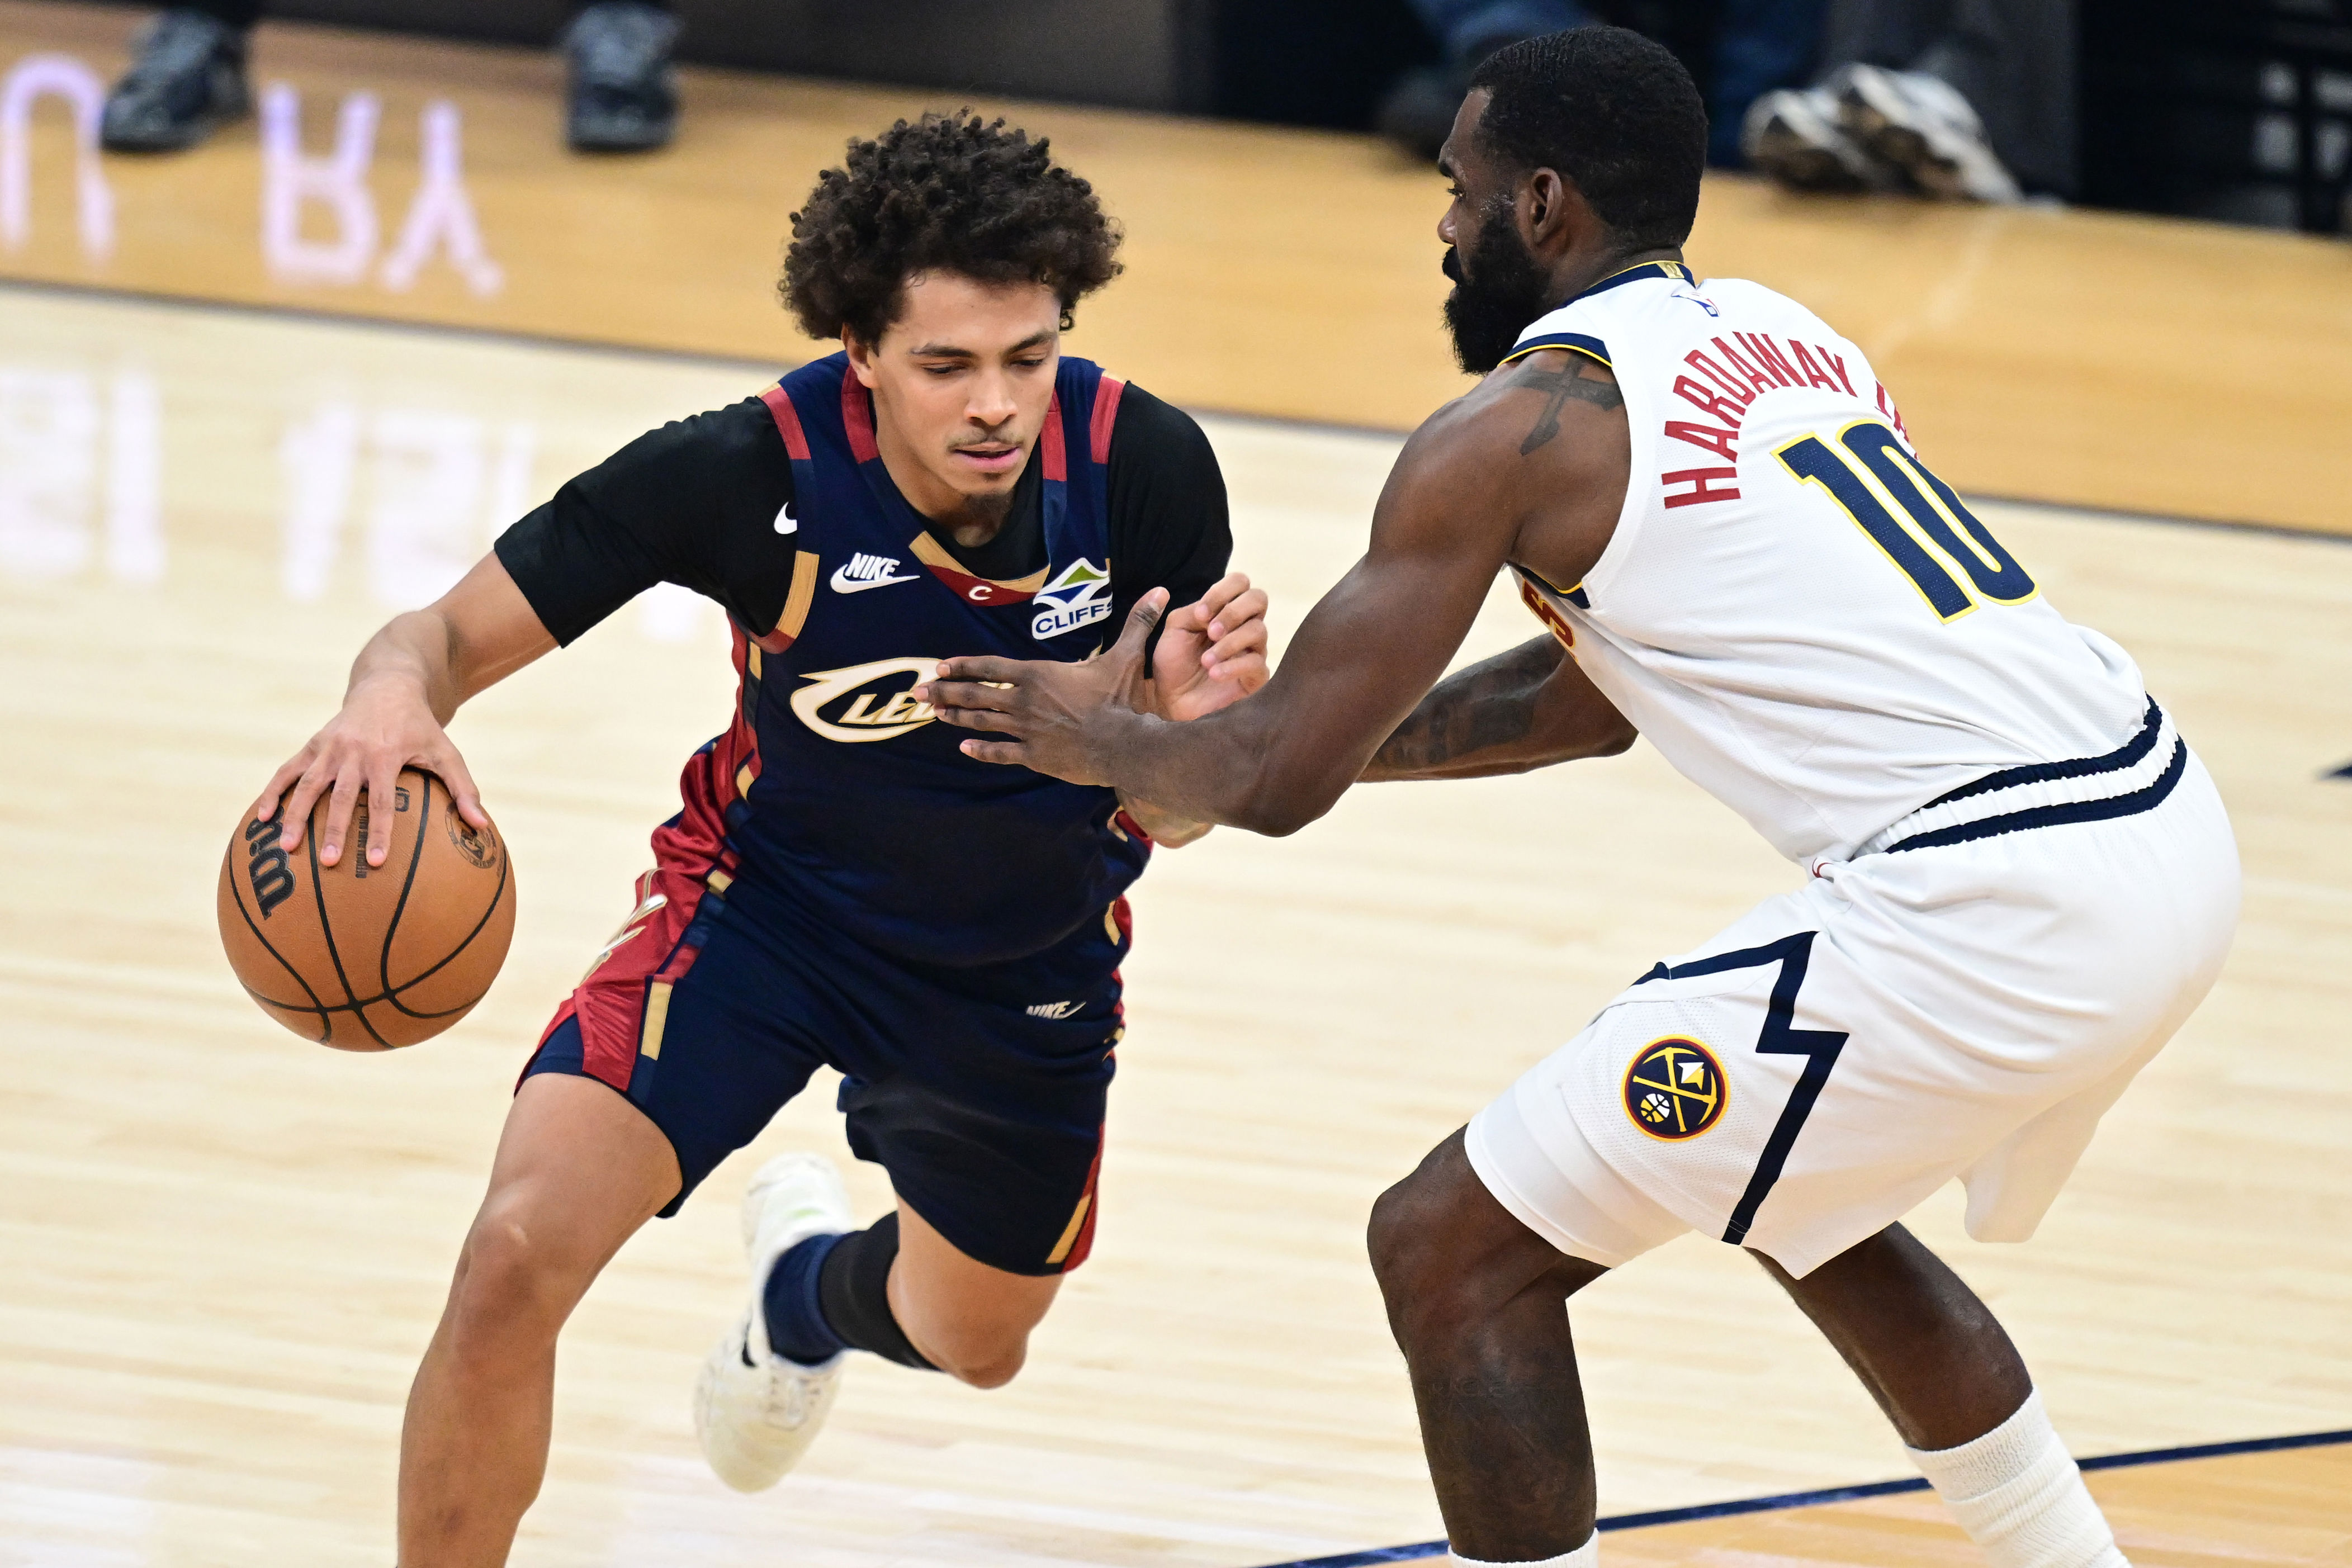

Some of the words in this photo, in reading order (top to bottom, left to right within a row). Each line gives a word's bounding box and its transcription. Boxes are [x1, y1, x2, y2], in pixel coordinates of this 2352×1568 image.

[1662, 331, 1858, 509] HARDAWAY
[1770, 419, 2040, 625] 10
[844, 552, 901, 581] NIKE
[968, 585, 993, 601] C
[1025, 1001, 1071, 1019] NIKE
